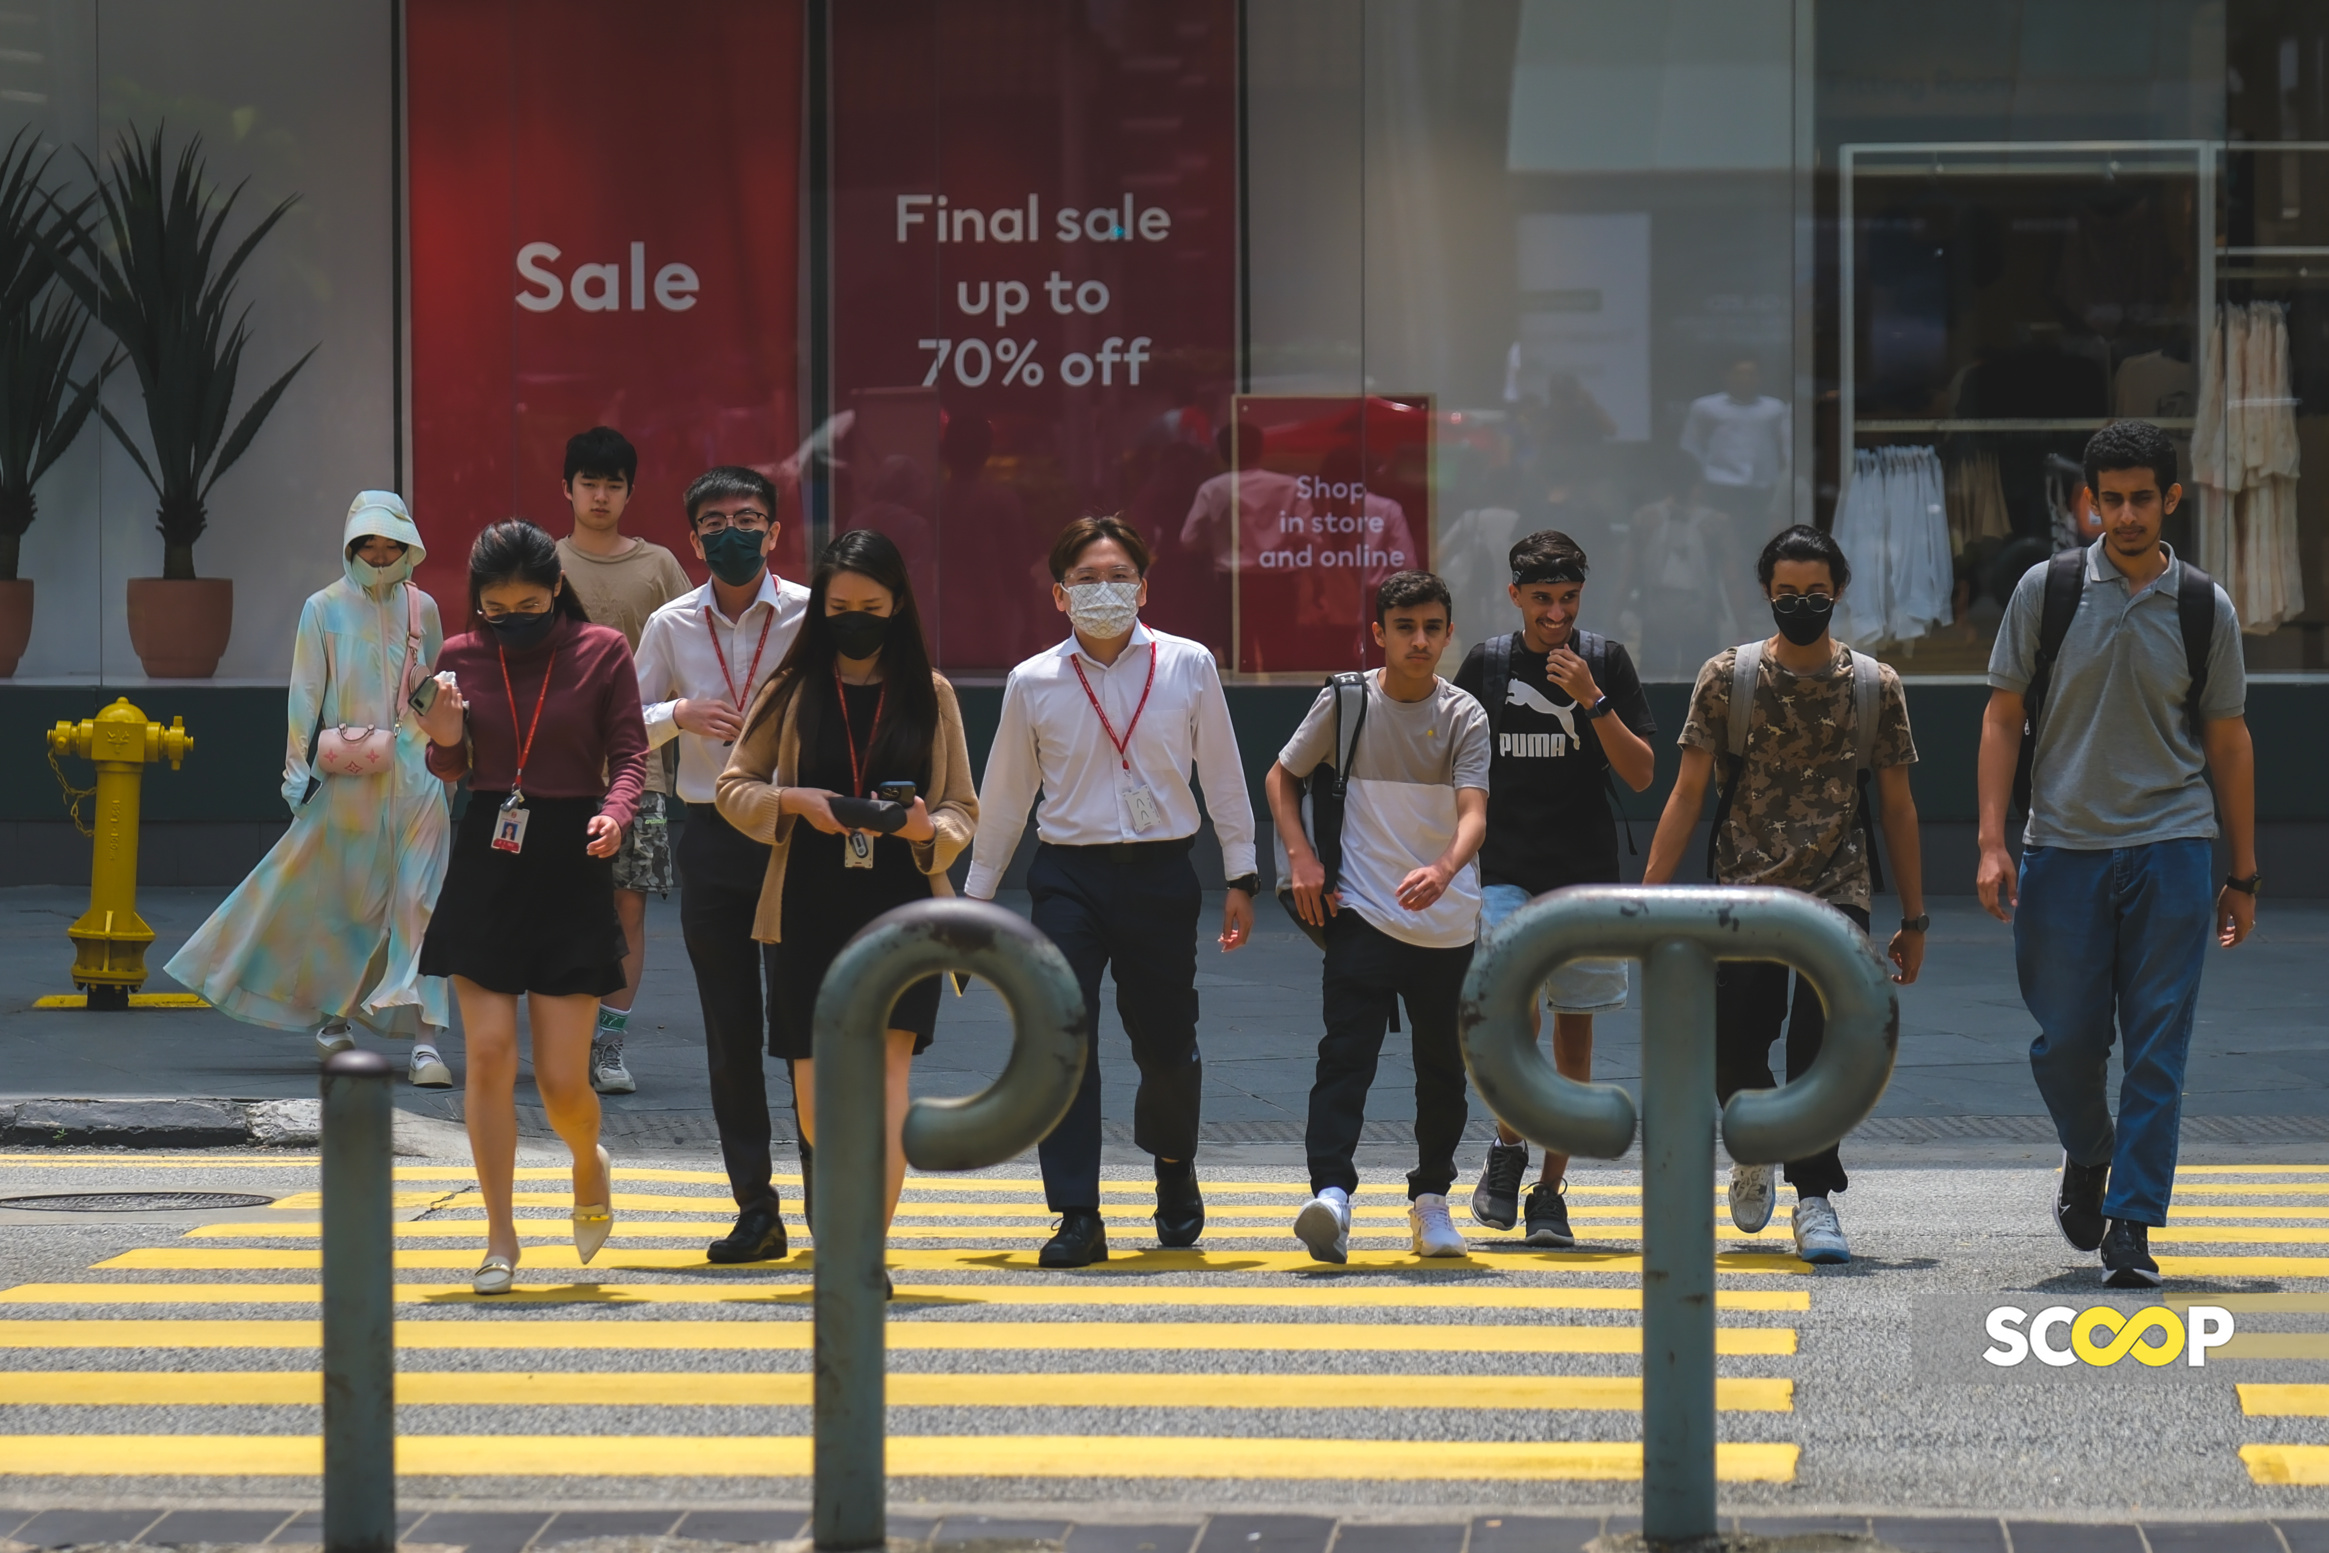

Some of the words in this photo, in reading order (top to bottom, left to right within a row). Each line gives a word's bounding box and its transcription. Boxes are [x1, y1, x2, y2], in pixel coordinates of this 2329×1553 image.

[896, 193, 1039, 243] Final
[1056, 193, 1171, 242] sale
[515, 241, 700, 313] Sale
[957, 280, 1030, 327] up
[1044, 271, 1110, 315] to
[918, 338, 1045, 387] 70%
[1060, 337, 1151, 386] off
[1296, 475, 1364, 504] Shop
[1279, 510, 1304, 533] in
[1312, 512, 1384, 533] store
[1259, 543, 1313, 568] and
[1320, 543, 1405, 568] online
[1499, 733, 1566, 757] PUMA
